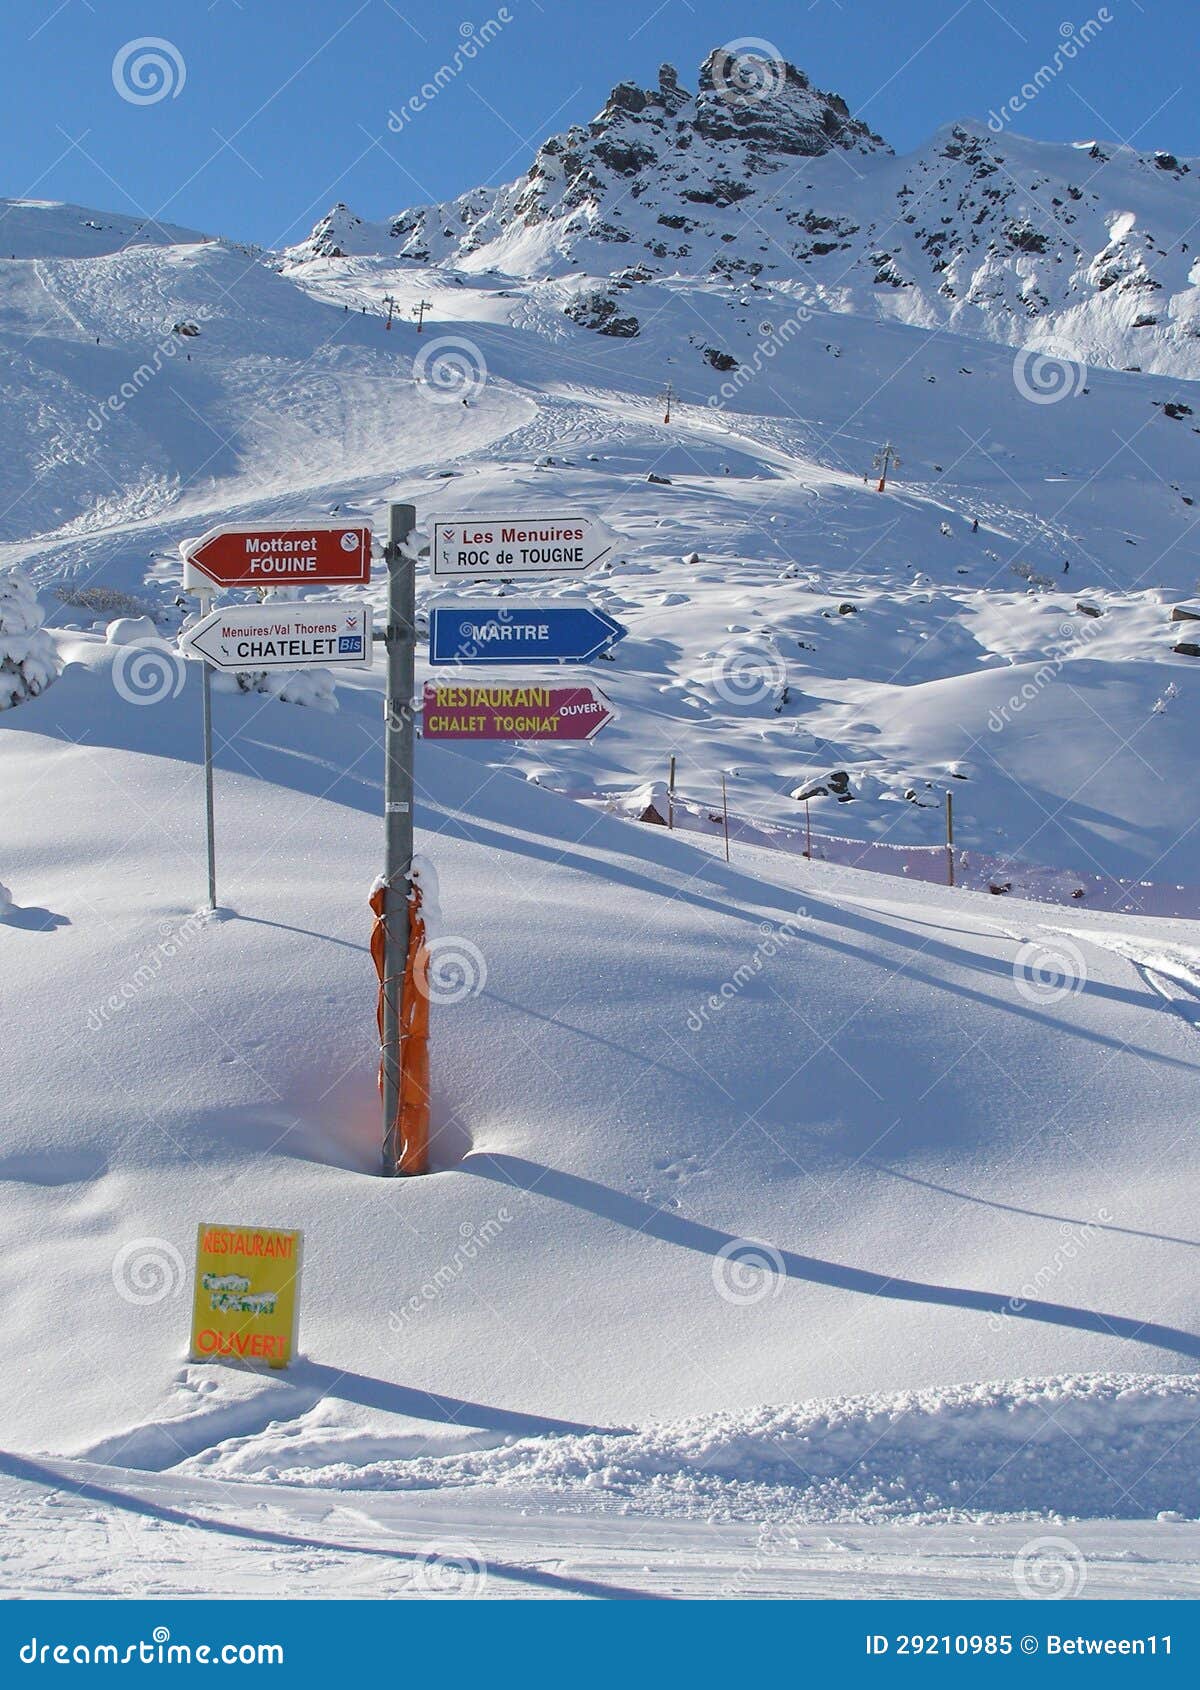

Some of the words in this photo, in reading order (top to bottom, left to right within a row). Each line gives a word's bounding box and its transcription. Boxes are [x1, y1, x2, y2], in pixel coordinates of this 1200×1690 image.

[463, 530, 493, 544] Les
[501, 528, 583, 543] Menuires
[245, 538, 317, 553] Mottaret
[458, 551, 489, 565] ROC
[496, 550, 513, 564] de
[520, 548, 583, 563] TOUGNE
[250, 557, 317, 573] FOUINE
[222, 623, 290, 638] Menuires/Val
[294, 622, 337, 635] Thorens
[471, 625, 549, 640] MARTRE
[237, 639, 336, 657] CHATELET
[340, 637, 360, 651] Bis
[436, 686, 551, 707] RESTAURANT
[429, 716, 486, 731] CHALET
[494, 717, 560, 732] TOGNIAT
[203, 1231, 294, 1258] RESTAURANT
[197, 1328, 288, 1359] OUVERT
